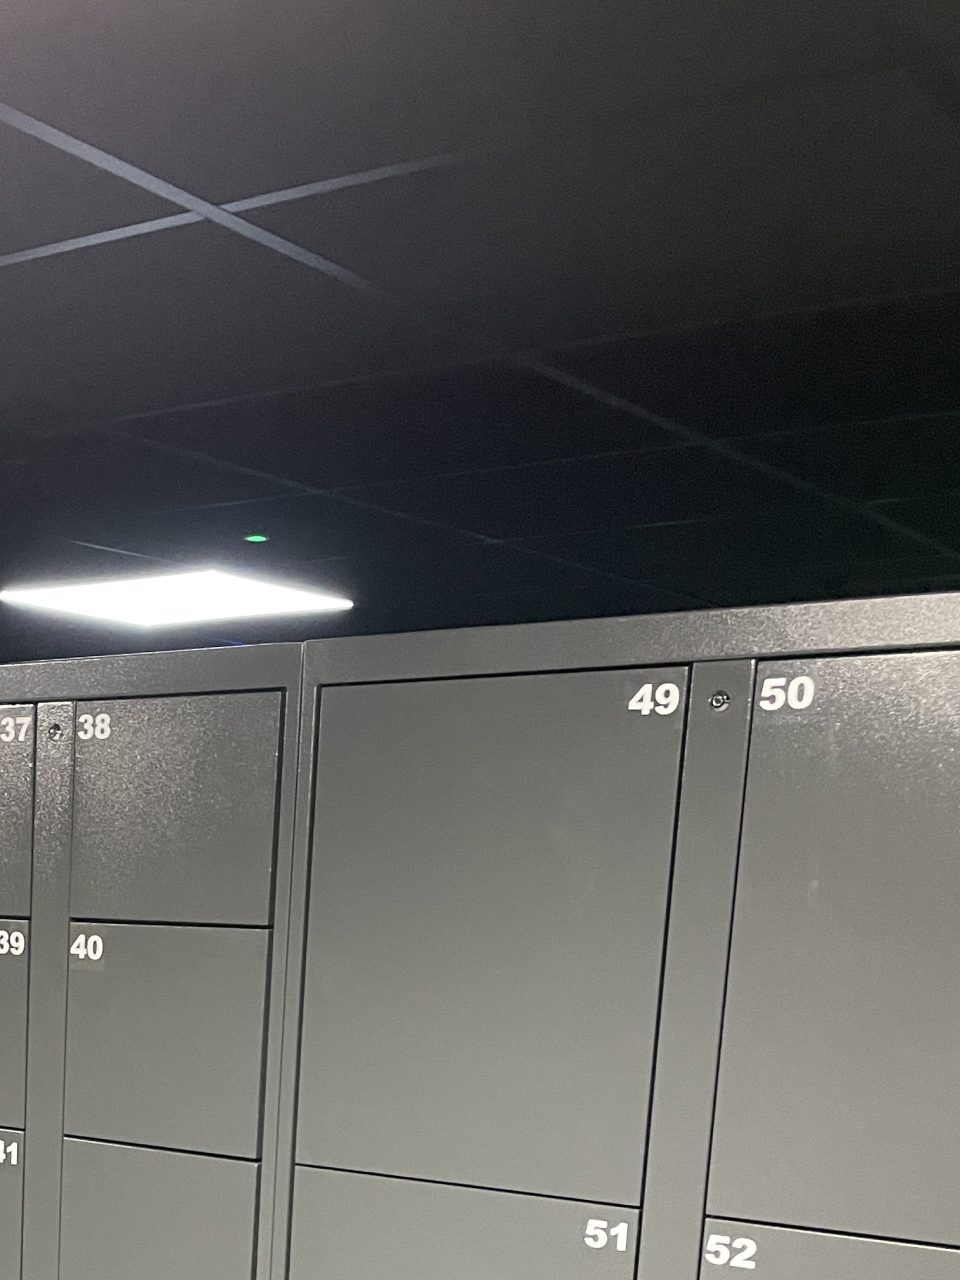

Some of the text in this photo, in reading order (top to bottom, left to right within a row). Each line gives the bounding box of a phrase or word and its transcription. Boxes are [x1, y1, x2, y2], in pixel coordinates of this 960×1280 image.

[627, 682, 680, 716] 49
[759, 675, 815, 711] 50
[0, 716, 32, 742] 37
[77, 713, 111, 740] 38
[69, 933, 104, 961] 40
[583, 1218, 629, 1252] 51
[704, 1234, 757, 1270] 52
